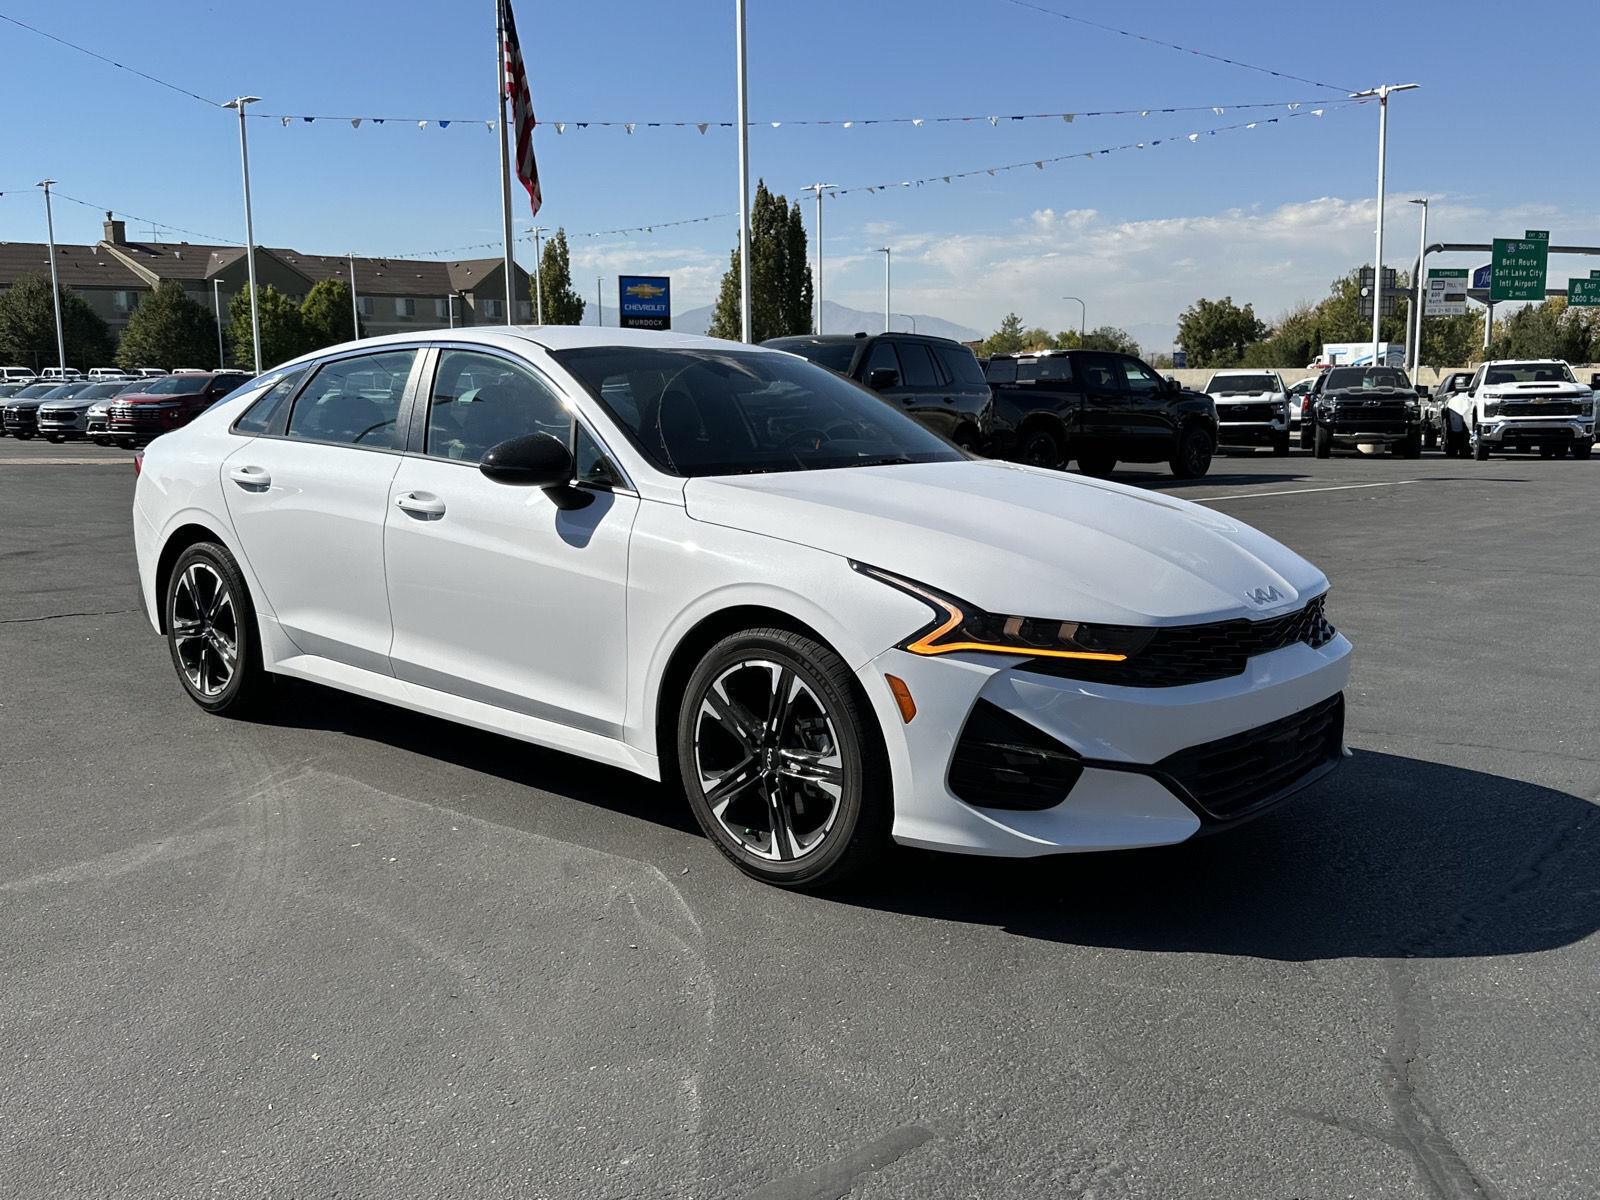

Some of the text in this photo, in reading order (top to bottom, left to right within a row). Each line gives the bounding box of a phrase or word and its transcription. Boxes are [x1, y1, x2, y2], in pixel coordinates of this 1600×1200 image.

[1502, 258, 1537, 267] Belt Route
[1495, 269, 1543, 279] Salt Lake City
[1514, 280, 1537, 289] Airport
[1571, 295, 1587, 303] 2600
[624, 304, 666, 312] CHEVROLET
